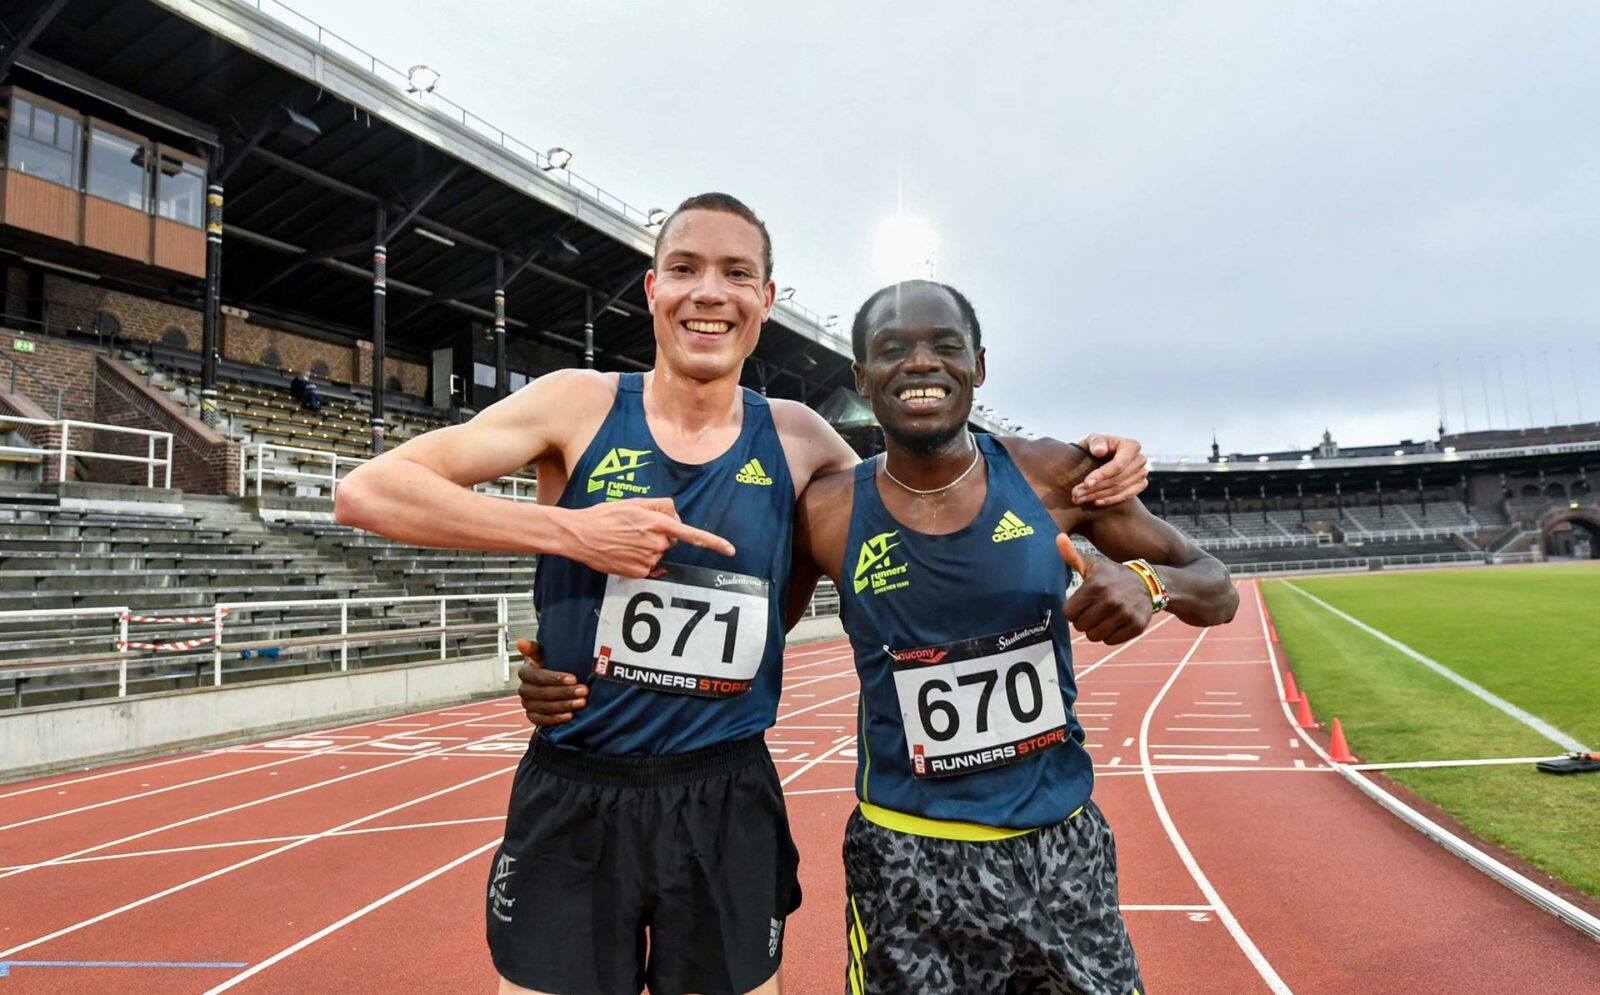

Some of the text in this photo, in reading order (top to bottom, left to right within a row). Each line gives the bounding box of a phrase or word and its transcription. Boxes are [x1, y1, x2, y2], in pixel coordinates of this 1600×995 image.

[736, 473, 773, 486] adidas
[607, 487, 624, 498] lab
[992, 526, 1034, 543] adidas
[872, 578, 887, 589] lab
[622, 592, 741, 664] 671
[613, 665, 697, 689] RUNNERS
[918, 661, 1043, 742] 670
[931, 745, 1016, 772] RUNNERS
